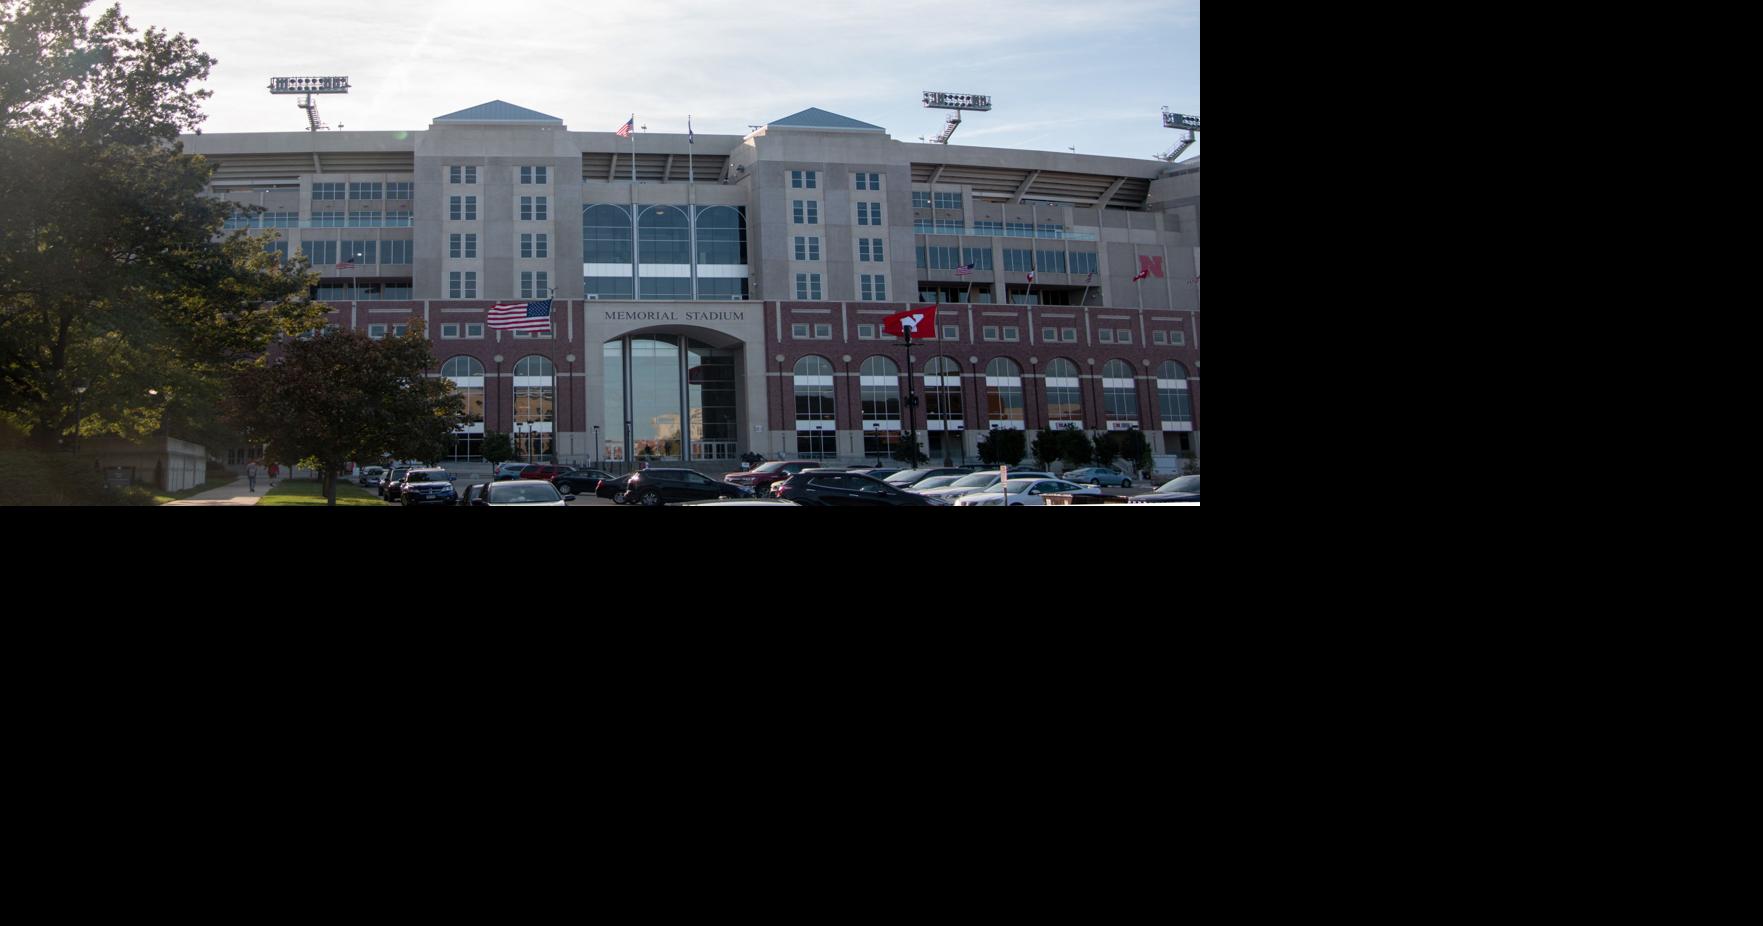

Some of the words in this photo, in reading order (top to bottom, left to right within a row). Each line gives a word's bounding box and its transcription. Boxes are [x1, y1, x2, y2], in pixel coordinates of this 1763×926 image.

[1140, 255, 1164, 277] N
[604, 311, 679, 320] MEMORIAL
[685, 311, 744, 320] STADIUM
